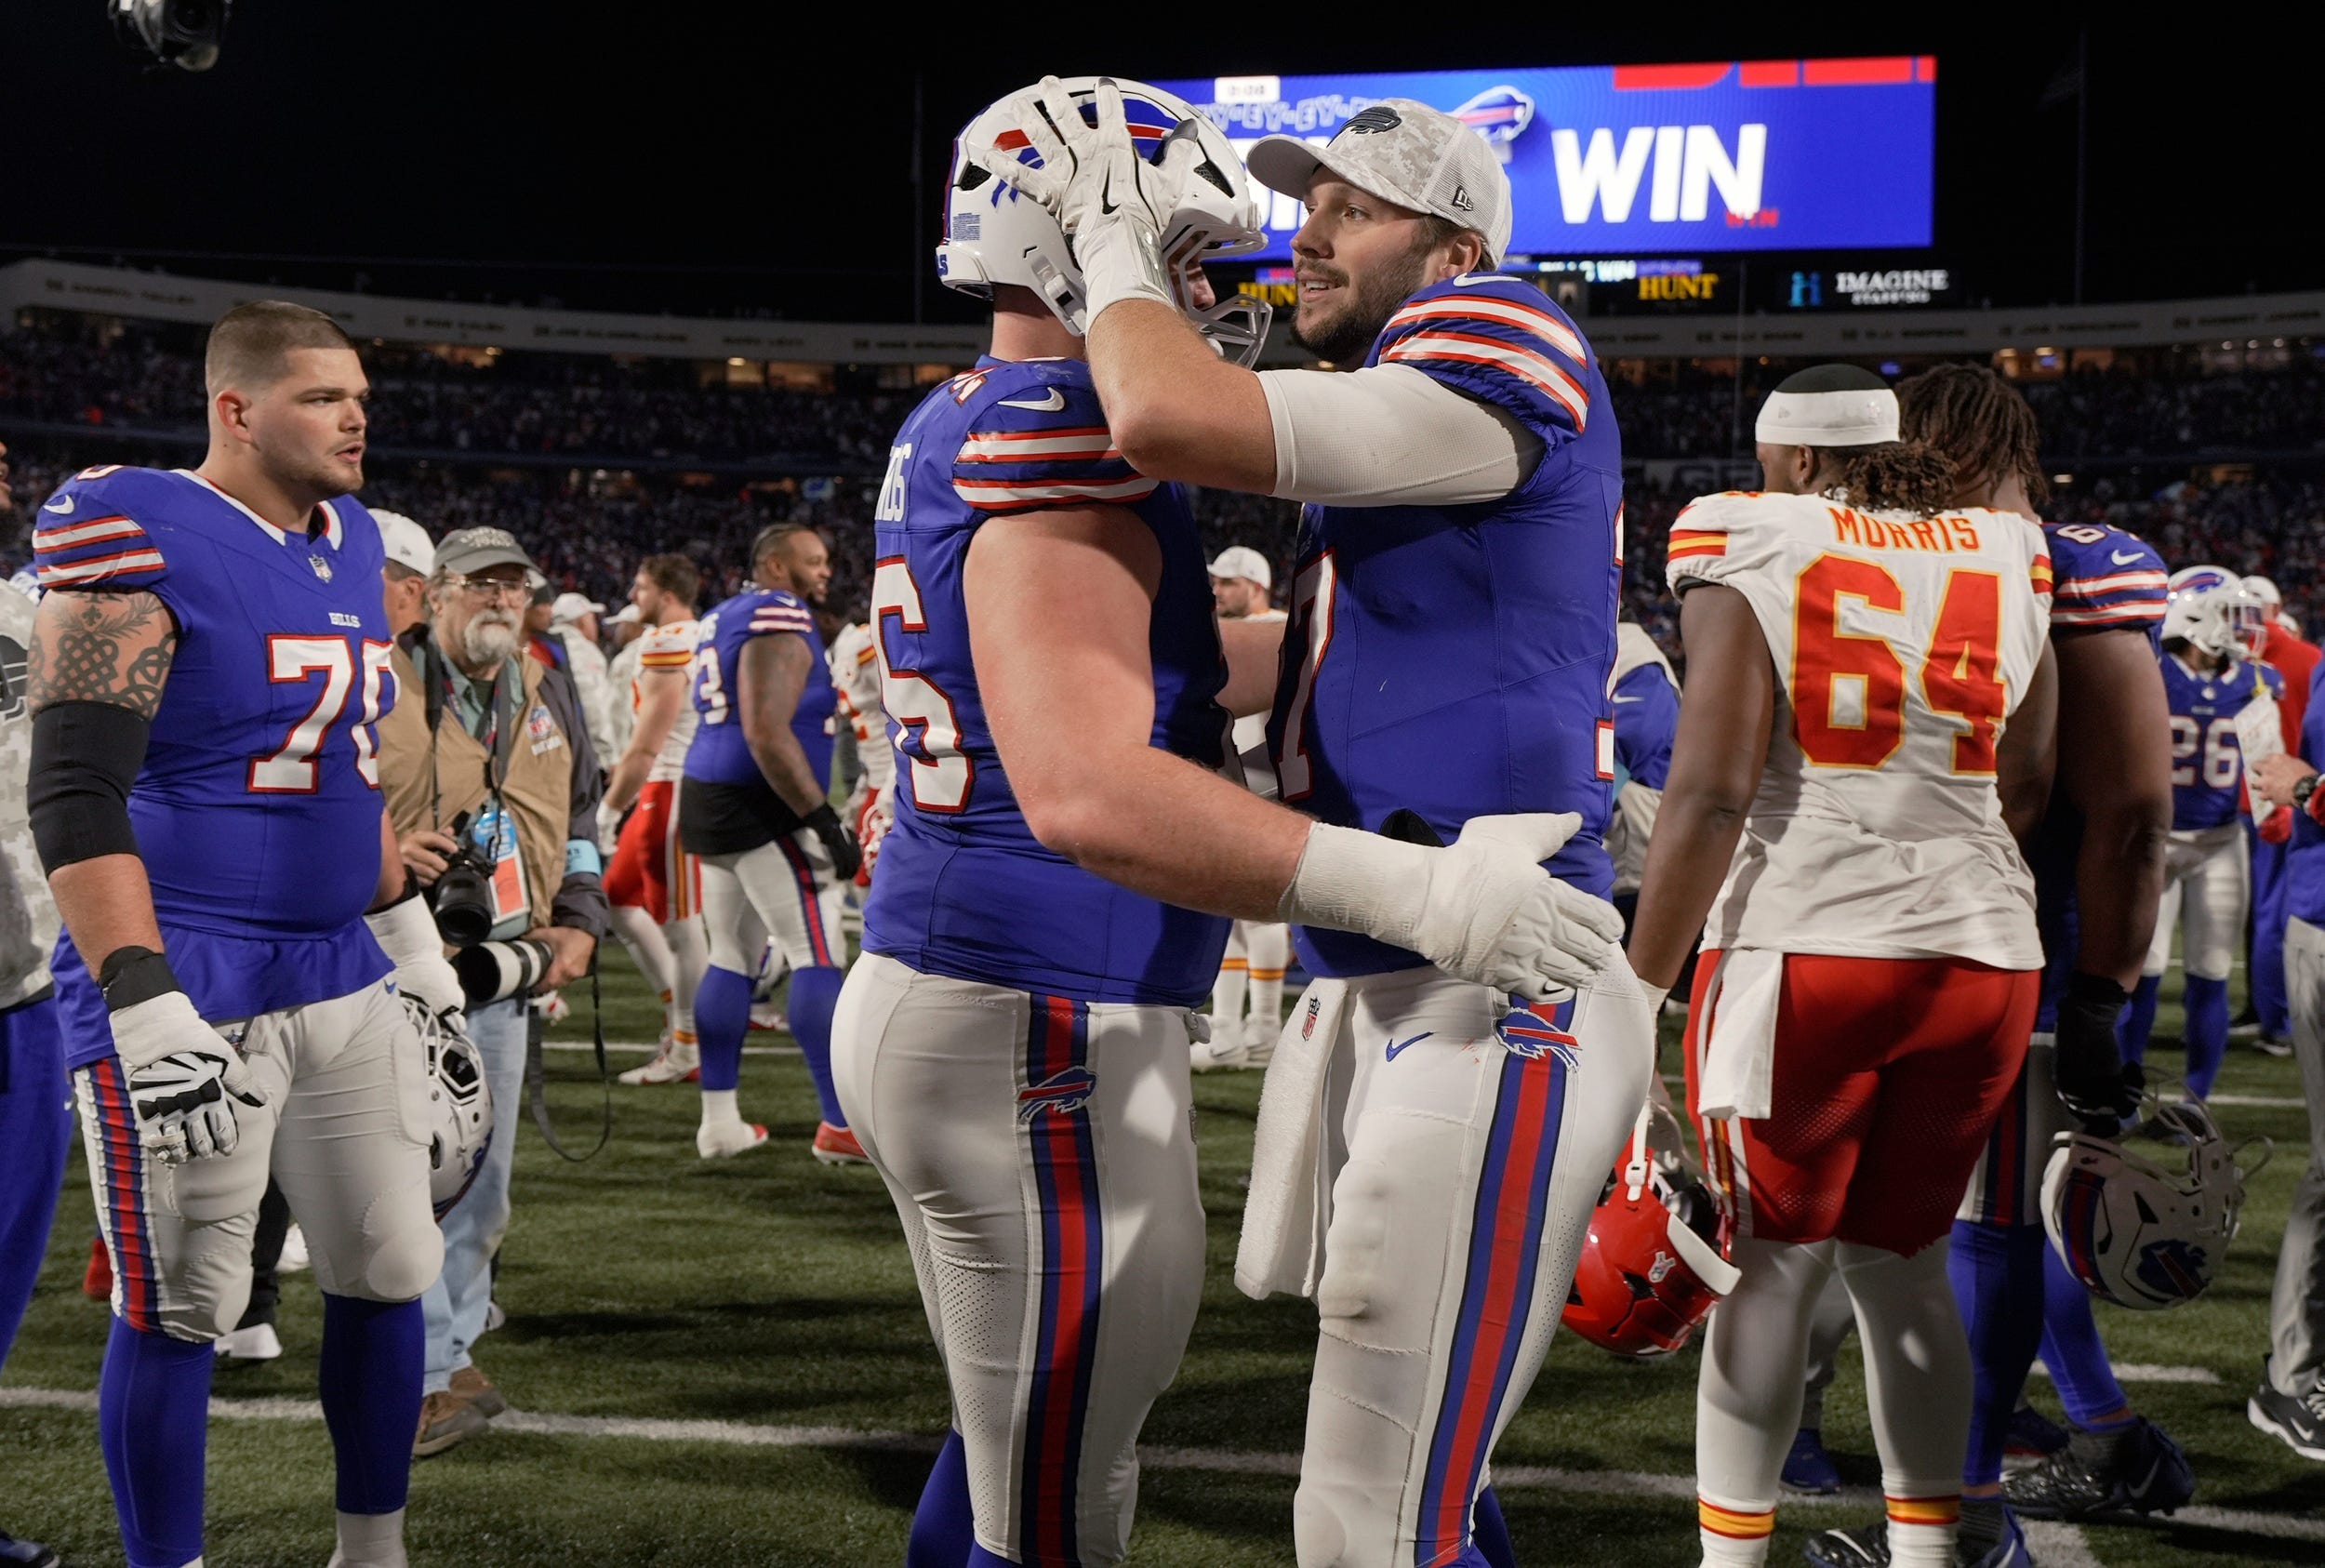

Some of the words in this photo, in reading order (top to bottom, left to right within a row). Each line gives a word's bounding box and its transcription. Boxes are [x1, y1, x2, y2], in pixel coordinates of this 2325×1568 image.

[1551, 124, 1767, 223] WIN
[1238, 283, 1296, 307] HUN
[1639, 273, 1719, 299] HUNT
[1836, 270, 1949, 293] IMAGINE
[1827, 507, 1982, 552] MORRIS
[1788, 550, 2009, 777] 64
[247, 634, 402, 794] 70
[2170, 715, 2241, 790] 26
